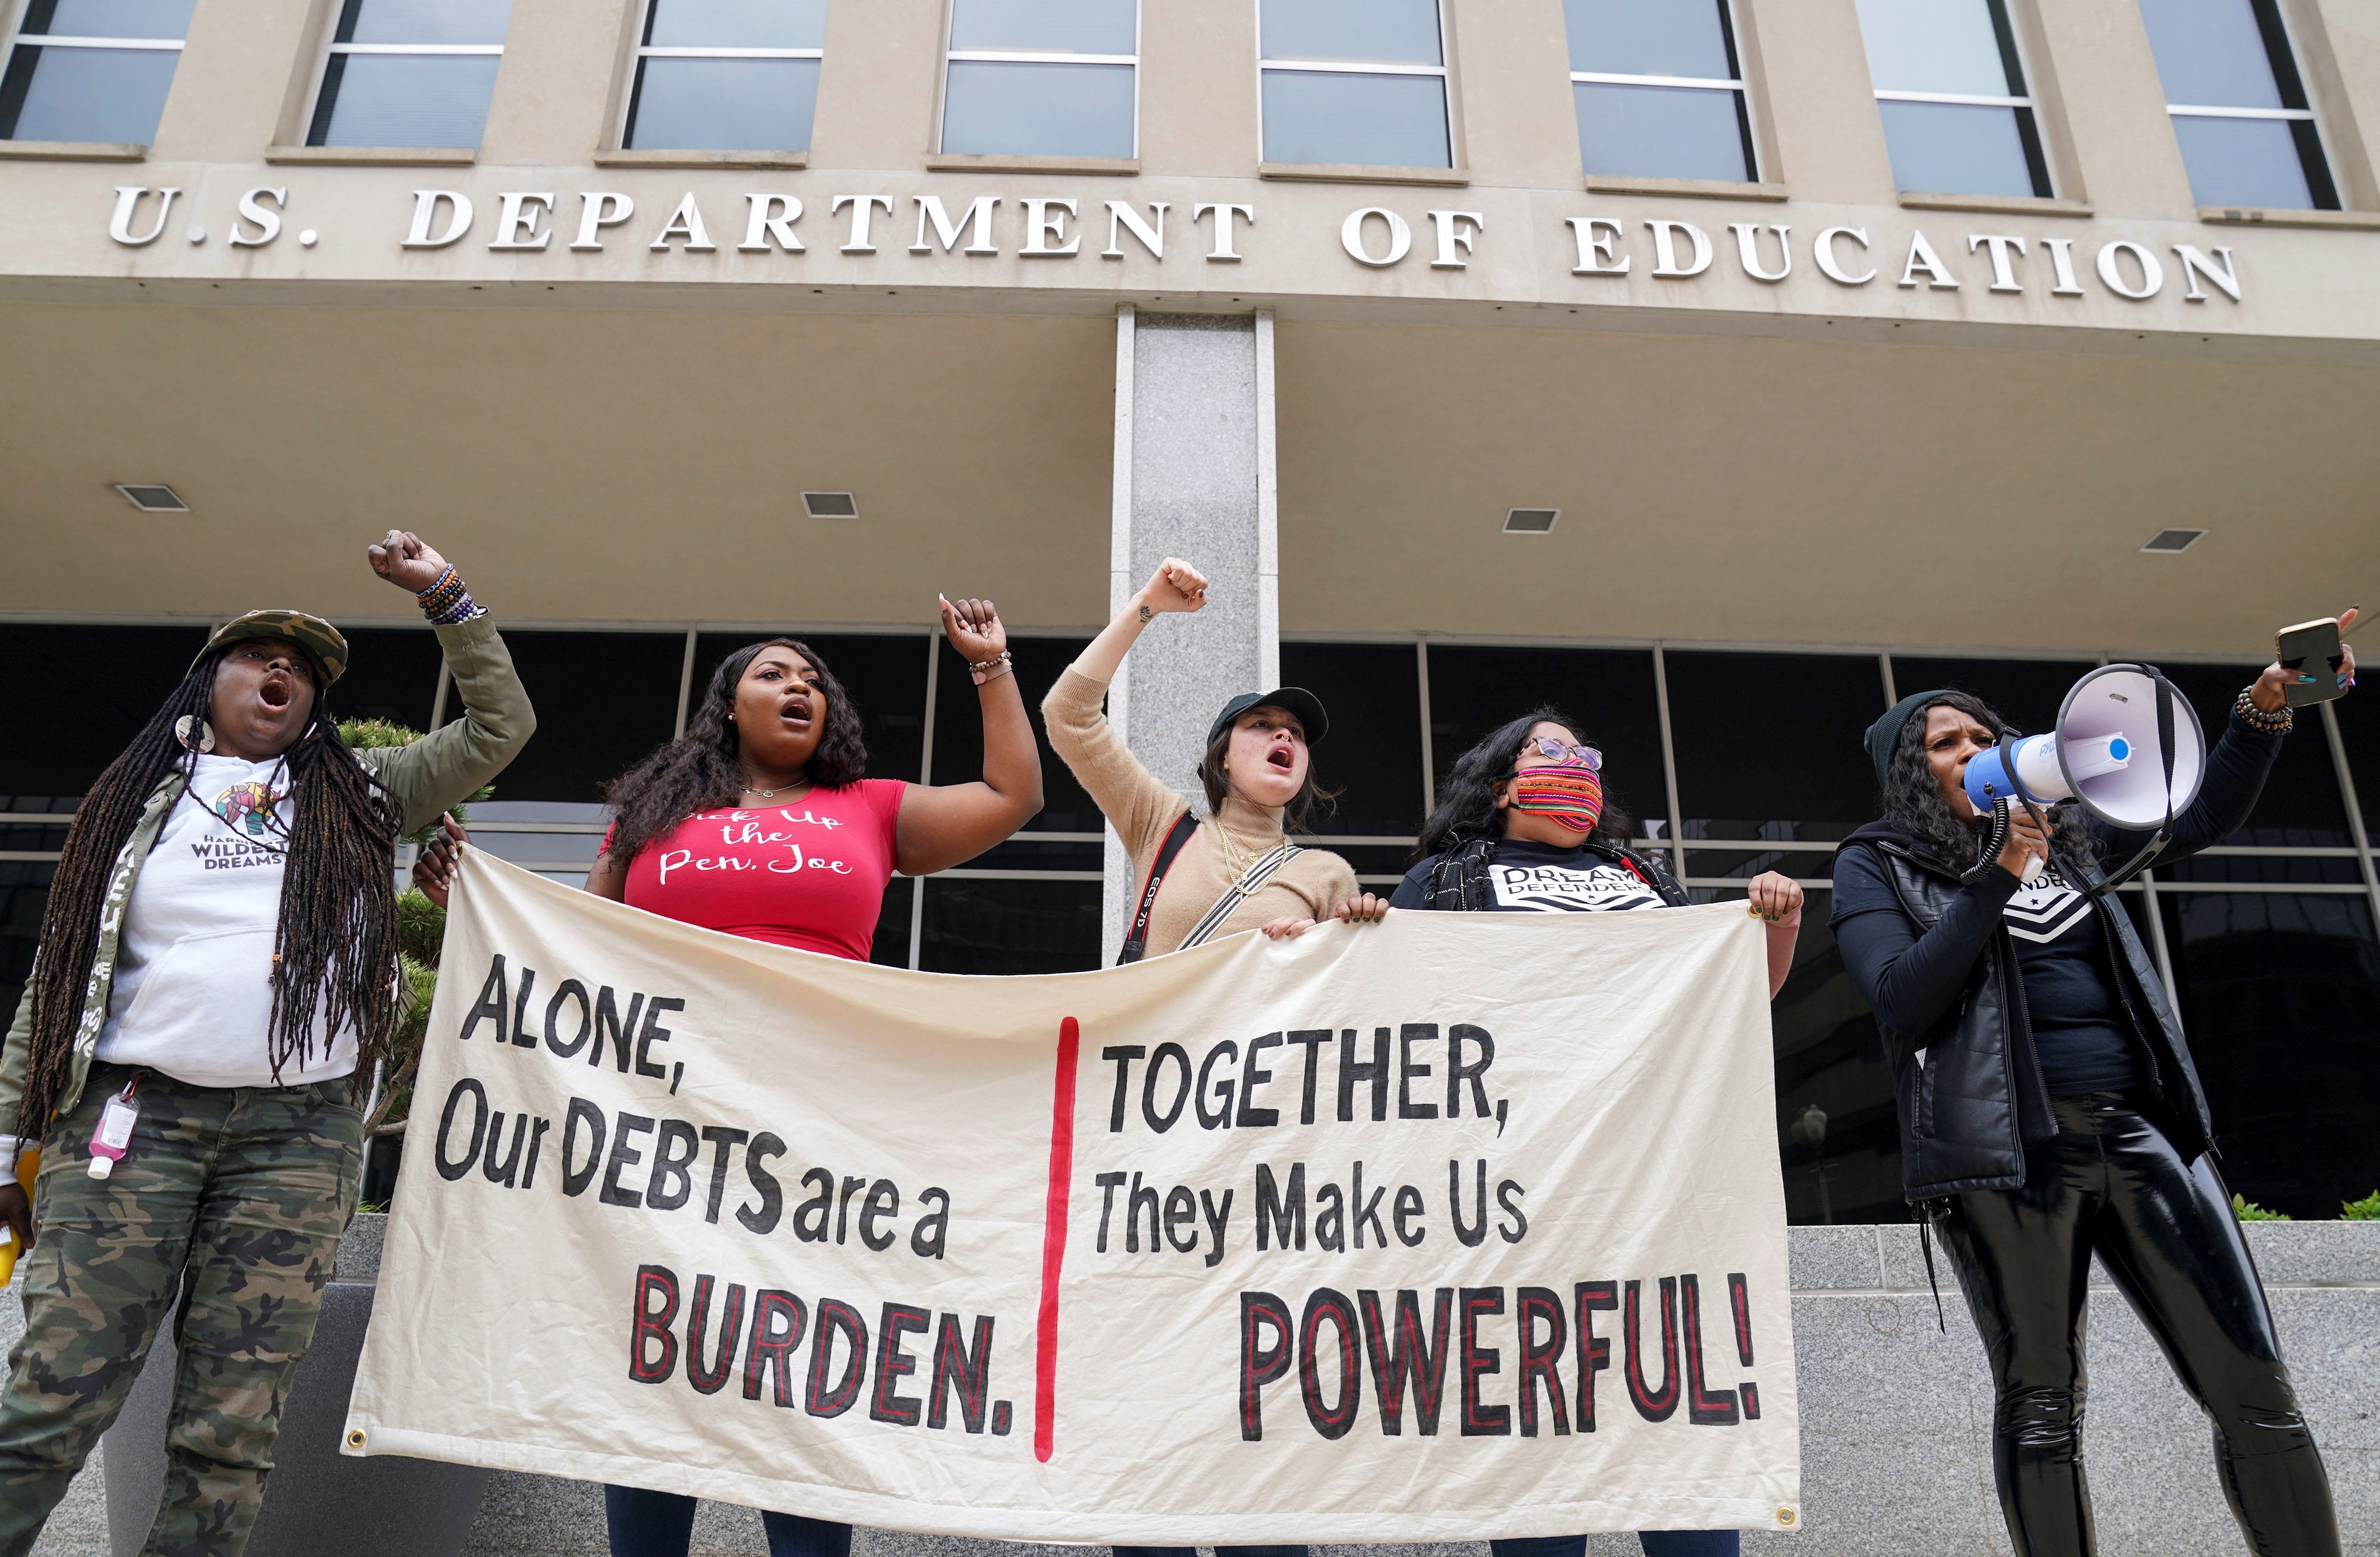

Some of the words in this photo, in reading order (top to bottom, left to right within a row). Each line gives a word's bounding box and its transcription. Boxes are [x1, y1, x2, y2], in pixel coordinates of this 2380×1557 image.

[109, 186, 318, 248] U.S.
[401, 189, 1254, 262] DEPARTMENT
[1341, 206, 1484, 269] OF
[1565, 217, 2241, 302] EDUCATION
[720, 822, 793, 844] the
[780, 810, 844, 829] Up
[205, 854, 283, 870] DREAMS
[768, 844, 853, 875] Joe
[1502, 867, 1642, 885] DREAM
[1508, 882, 1652, 895] DEFENDERS
[1144, 877, 1161, 908] EOS
[1137, 911, 1148, 928] 7D
[459, 953, 685, 1096] ALONE,
[1102, 1023, 1509, 1139] TOGETHER,
[434, 1077, 549, 1189] Our
[561, 1097, 787, 1235] DEBTS
[793, 1166, 900, 1251] are
[910, 1185, 951, 1261] a
[1095, 1171, 1234, 1268] They
[1255, 1160, 1426, 1254] Make
[1449, 1158, 1528, 1248] Us
[628, 1264, 1013, 1437] BURDEN.
[1239, 1273, 1761, 1441] POWERFUL!
